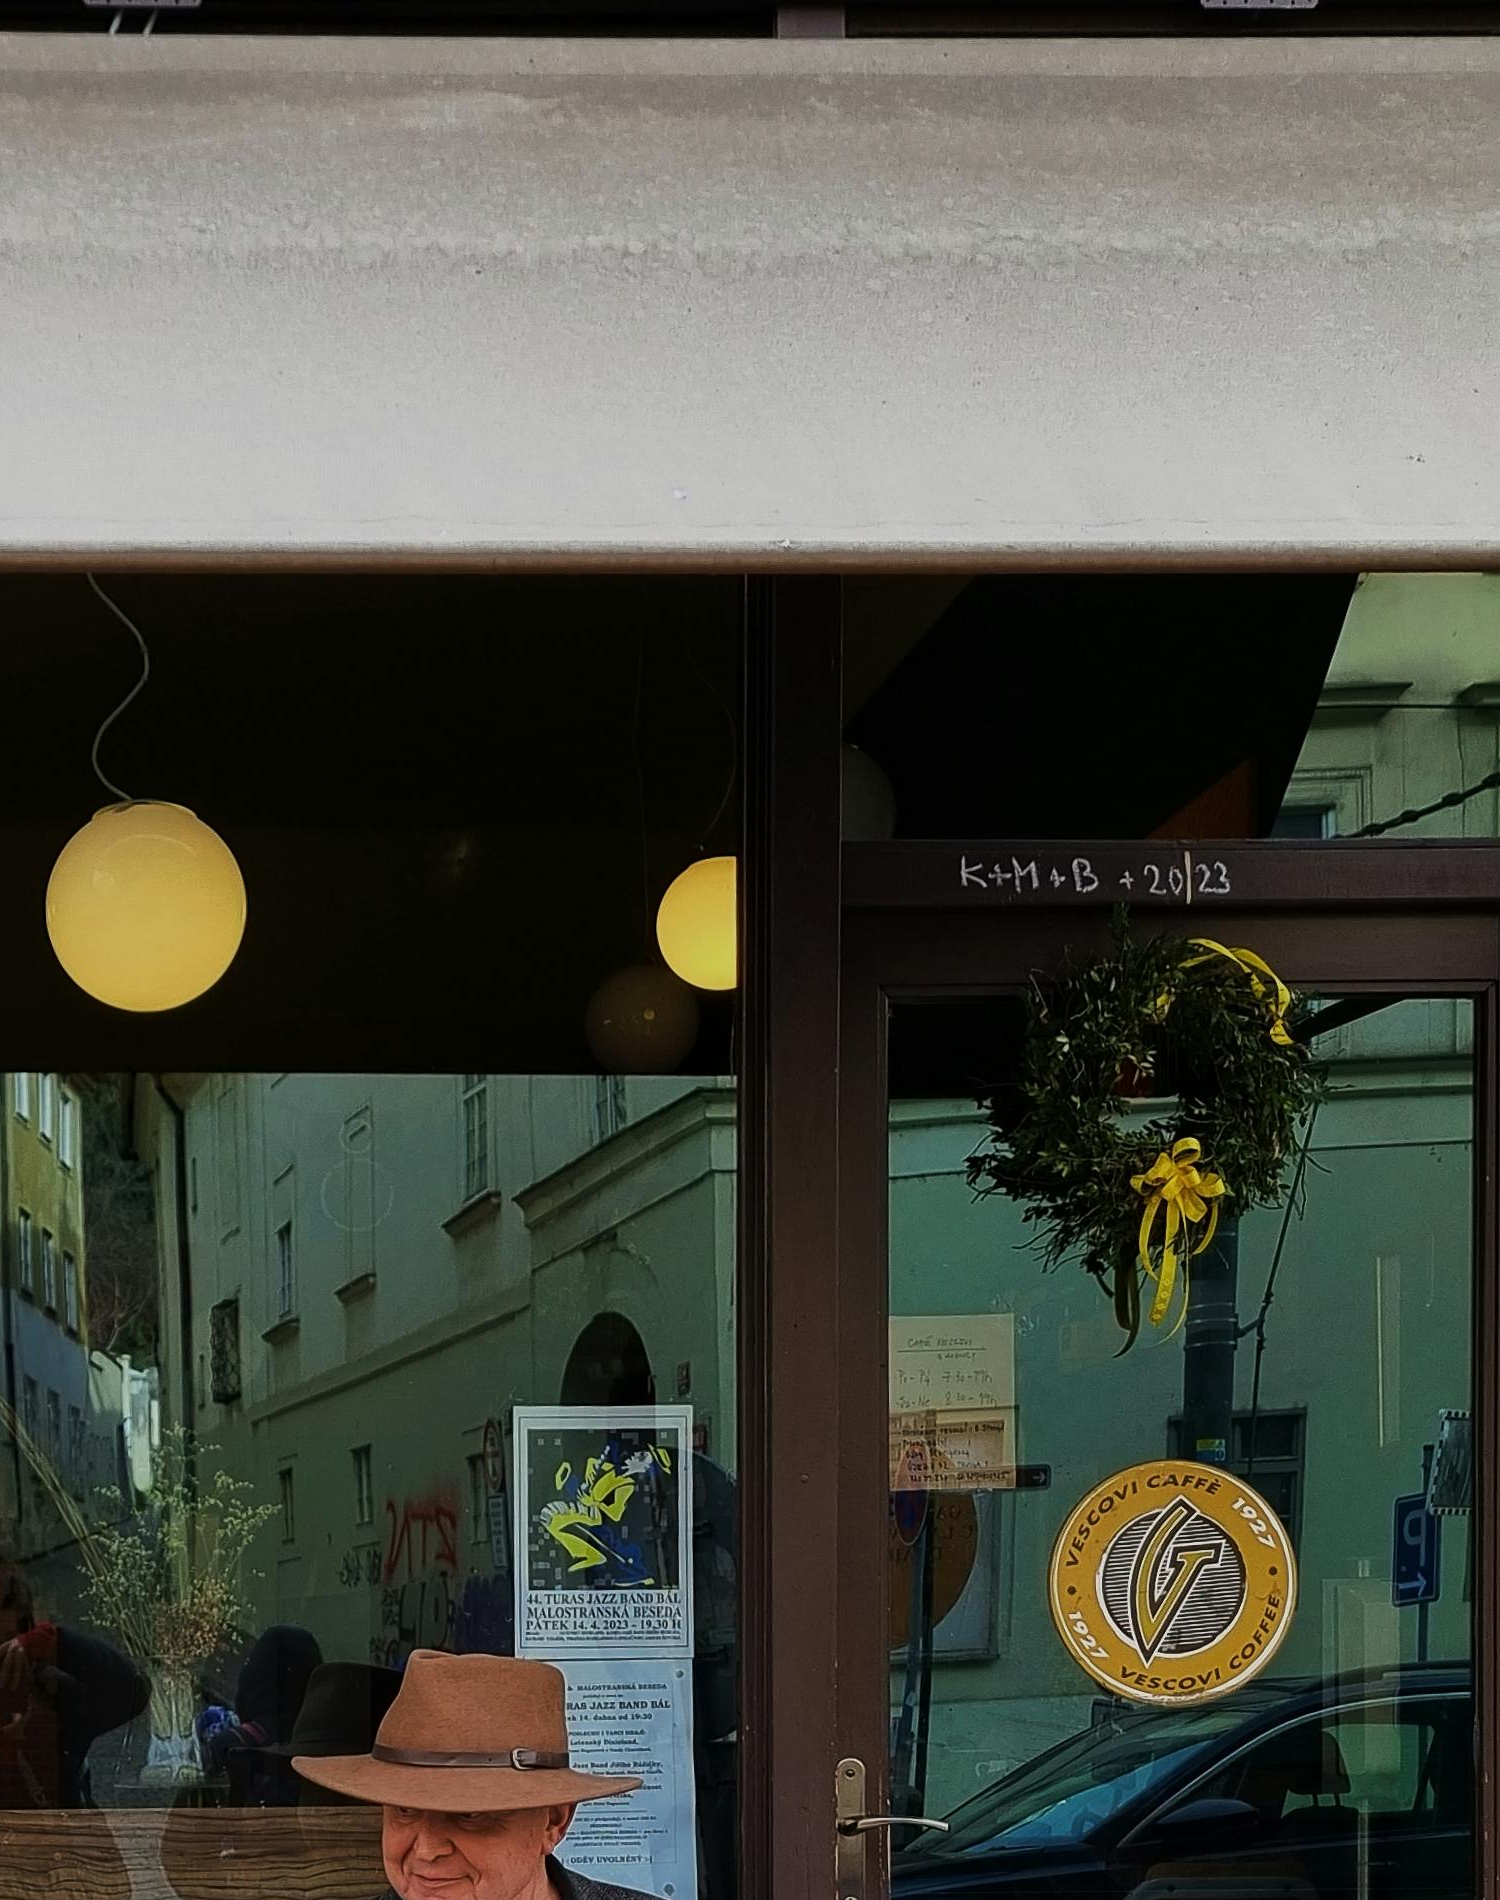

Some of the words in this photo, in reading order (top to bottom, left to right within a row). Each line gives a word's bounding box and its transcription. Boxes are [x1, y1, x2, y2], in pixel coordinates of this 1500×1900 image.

[1065, 1480, 1138, 1568] VESCOVI
[1146, 1473, 1222, 1496] CAFFÈ
[1231, 1497, 1277, 1550] 1927
[526, 1593, 542, 1604] 44.
[544, 1593, 585, 1604] TURAS
[586, 1593, 617, 1604] JAZZ
[621, 1593, 654, 1604] BAND
[657, 1591, 682, 1604] BÁL
[526, 1605, 630, 1619] MALOSTRANSKÁ
[633, 1607, 682, 1618] BESEDA
[525, 1618, 569, 1630] PÁTEK
[572, 1620, 588, 1630] 14.
[591, 1620, 601, 1630] 4.
[603, 1620, 629, 1630] 2023
[1228, 1594, 1281, 1670] COFFEE
[1068, 1610, 1111, 1659] 1927
[577, 1683, 637, 1691] MALOSTRANSKÁ
[1119, 1666, 1222, 1692] VESCOVI
[566, 1702, 587, 1710] RAS
[589, 1701, 616, 1710] JAZZ
[619, 1700, 648, 1709] BAND
[650, 1698, 671, 1709] BÁL
